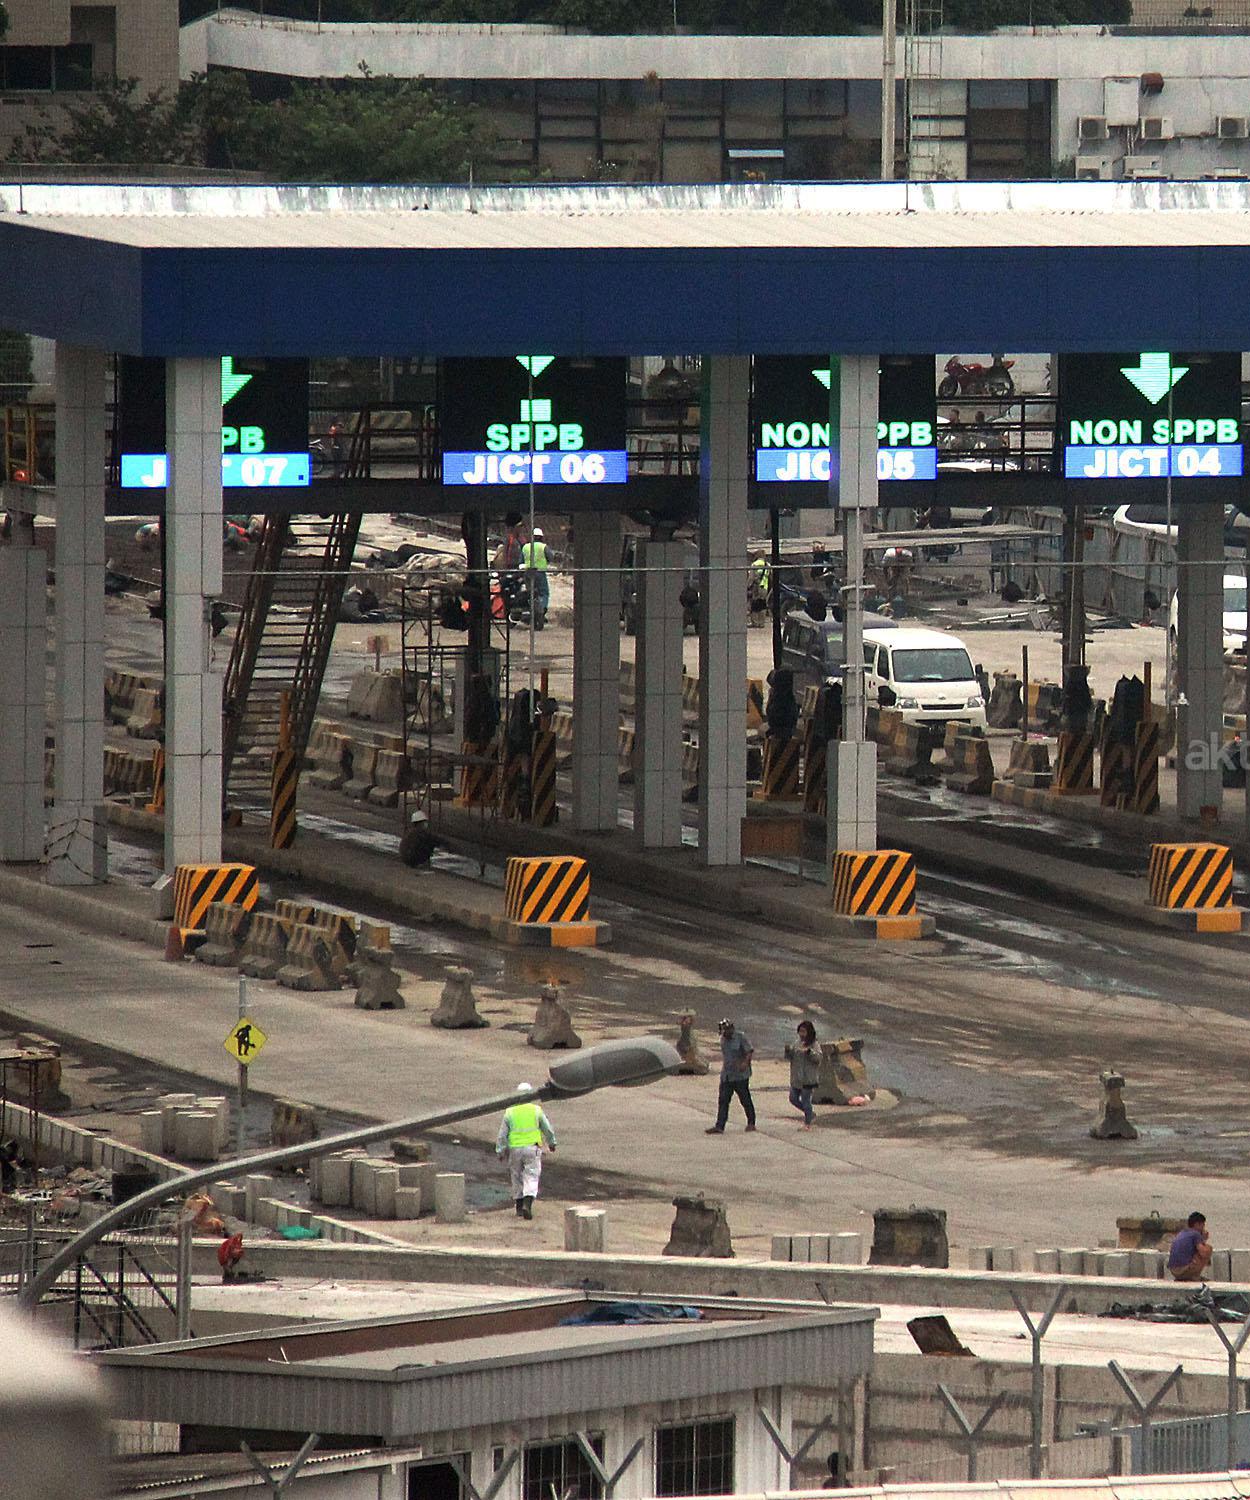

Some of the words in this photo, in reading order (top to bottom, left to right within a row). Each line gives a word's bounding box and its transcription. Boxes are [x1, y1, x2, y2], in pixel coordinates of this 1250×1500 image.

[221, 426, 265, 453] PB
[485, 423, 584, 451] SPPB
[761, 421, 830, 447] NON
[1070, 419, 1142, 445] NON
[1152, 418, 1239, 444] SPPB
[241, 457, 288, 487] 07
[462, 454, 551, 485] JICT
[559, 453, 606, 484] 06
[776, 451, 831, 481] JIC
[1083, 449, 1169, 478] JICT
[1177, 448, 1232, 477] 04
